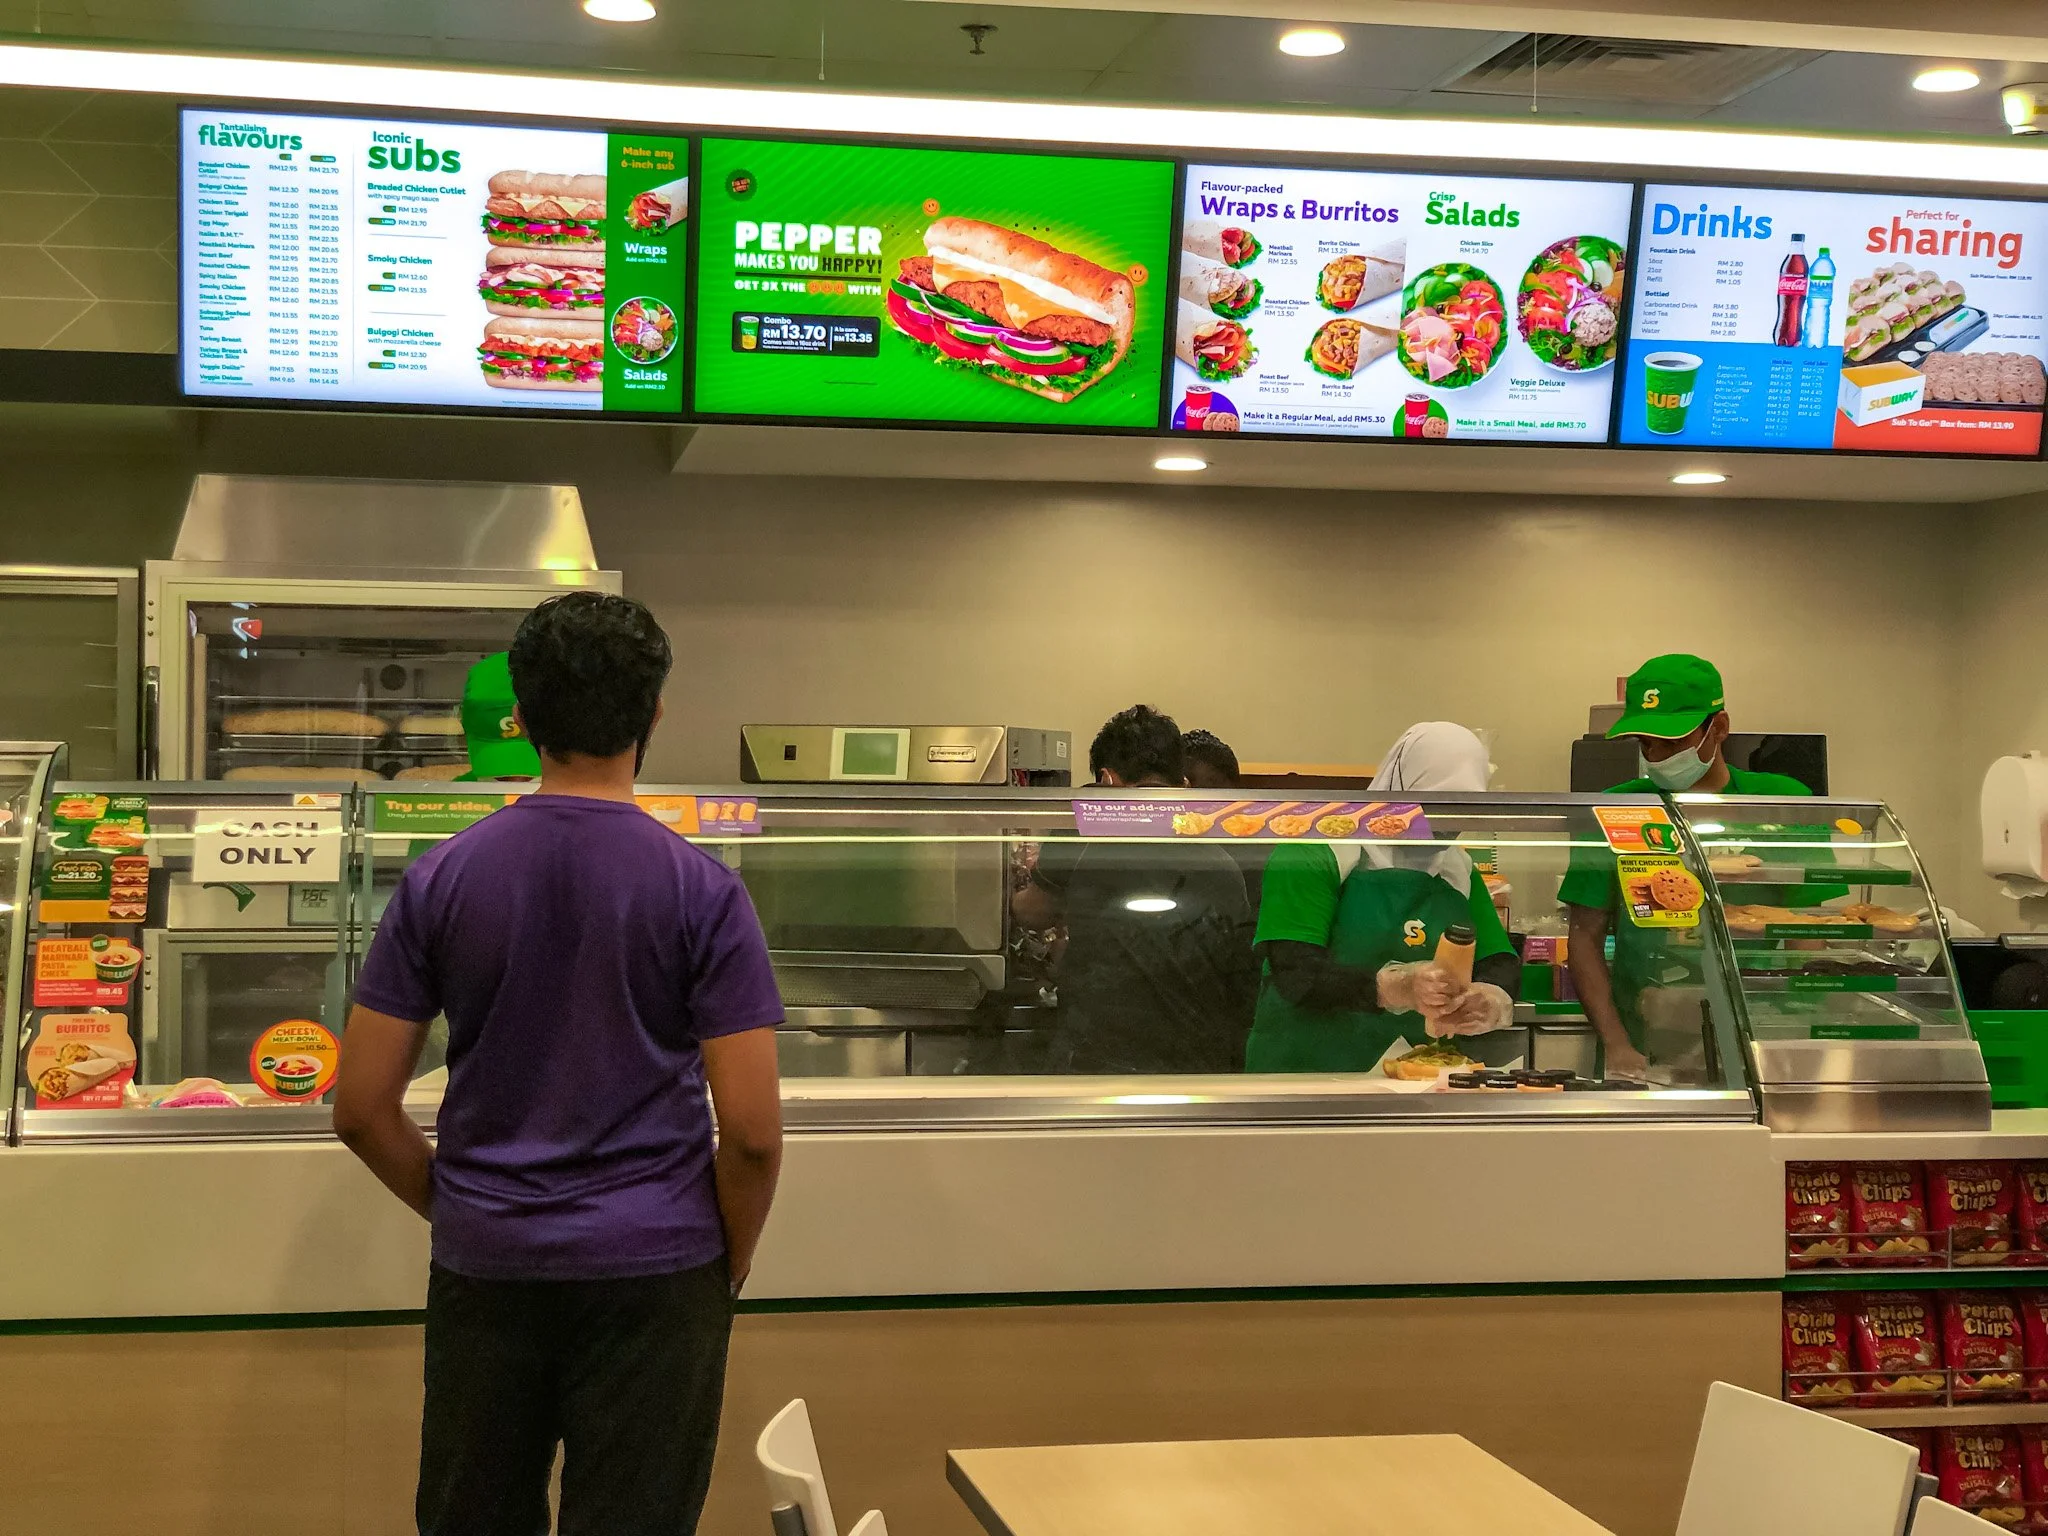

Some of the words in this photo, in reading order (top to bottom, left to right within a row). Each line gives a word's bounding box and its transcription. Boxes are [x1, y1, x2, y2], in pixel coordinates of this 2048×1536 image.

[219, 123, 267, 134] Tantalising
[198, 125, 302, 150] flavours
[373, 131, 412, 144] Iconic
[368, 138, 461, 174] subs
[623, 147, 651, 156] Make
[654, 150, 673, 160] any
[621, 160, 653, 168] 6-inch
[656, 162, 675, 170] sub
[368, 183, 402, 192] Breaded
[405, 184, 438, 193] Chicken
[440, 186, 466, 195] Cutlet
[1201, 182, 1283, 194] Flavour-packed
[1429, 192, 1456, 203] Crisp
[1200, 195, 1278, 222] Wraps
[1284, 205, 1296, 219] &
[1302, 200, 1399, 223] Burritos
[1425, 201, 1520, 228] Salads
[1906, 210, 1942, 220] Perfect
[1946, 211, 1960, 221] for
[1652, 203, 1772, 240] Drinks
[736, 221, 882, 256] PEPPER
[1866, 216, 2023, 269] sharing
[624, 242, 667, 257] Wraps
[368, 255, 397, 264] Smoky
[399, 256, 432, 264] Chicken
[734, 253, 785, 269] MAKES
[788, 254, 818, 271] YOU
[822, 257, 882, 274] HAPPY!
[734, 280, 760, 290] GET
[762, 281, 778, 291] 3X
[781, 282, 806, 293] THE
[848, 285, 881, 295] WITH
[368, 328, 400, 337] Bulgogi
[402, 329, 434, 338] Chicken
[624, 369, 667, 381] Salads
[1510, 379, 1537, 388] Veggie
[1867, 390, 1918, 411] SUBWAY
[1282, 413, 1312, 423] Regular
[1314, 414, 1336, 422] Meal,
[1517, 421, 1538, 429] Meal,
[385, 800, 412, 812] Try
[1080, 804, 1101, 812] Try
[222, 822, 318, 838] CASH
[220, 847, 316, 864] ONLY
[42, 944, 89, 952] MEATBALL
[56, 1024, 111, 1034] BURRITOS
[276, 1028, 316, 1036] CHEESY
[1789, 1170, 1840, 1187] Potato
[1856, 1170, 1912, 1187] Potato
[1948, 1178, 2002, 1194] Potato
[1792, 1186, 1841, 1206] Chips
[1861, 1184, 1912, 1202] Chips
[1950, 1194, 1997, 1211] Chips
[1787, 1312, 1836, 1328] Potato
[1867, 1305, 1924, 1322] Potato
[1960, 1304, 2014, 1321] Potato
[1874, 1319, 1925, 1338] Chips
[1963, 1318, 2014, 1338] Chips
[1792, 1328, 1836, 1346] Chips
[1954, 1436, 2004, 1452] Potato
[1958, 1451, 2003, 1470] Chips
